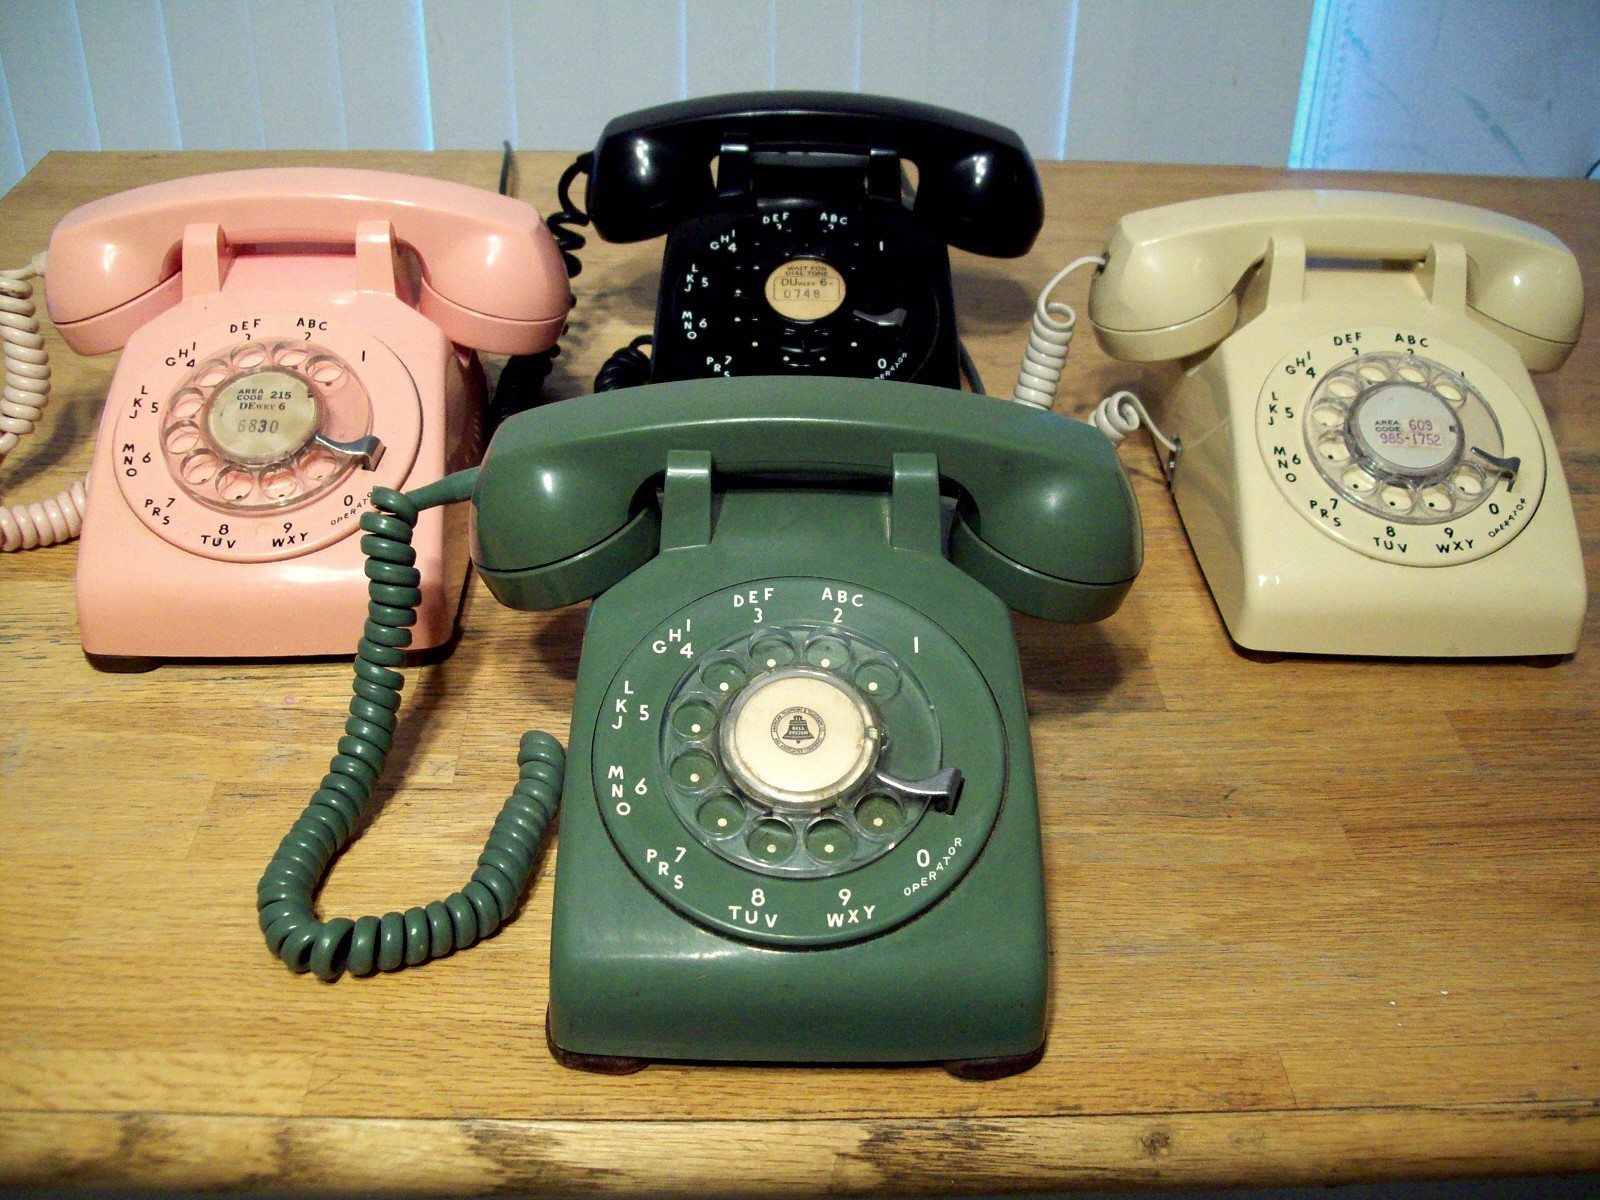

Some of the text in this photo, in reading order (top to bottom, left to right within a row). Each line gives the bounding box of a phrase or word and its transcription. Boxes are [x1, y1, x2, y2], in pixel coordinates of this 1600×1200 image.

[762, 211, 790, 225] DEF
[820, 211, 848, 225] ABC
[727, 242, 737, 252] 4
[701, 277, 709, 288] 5
[784, 289, 820, 299] 0748
[229, 318, 262, 334] DEF
[296, 317, 328, 331] ABC
[699, 318, 708, 329] 6
[1333, 331, 1362, 346] DEF
[1394, 333, 1429, 348] ABC
[186, 358, 196, 368] 4
[724, 355, 733, 365] 7
[1306, 366, 1317, 379] 4
[270, 390, 292, 400] 215
[150, 402, 159, 414] 5
[278, 402, 286, 411] 6
[1285, 406, 1295, 419] 5
[237, 419, 279, 434] 6830
[1409, 420, 1433, 431] 609
[1380, 432, 1442, 447] 985-1752
[142, 452, 152, 464] 6
[1292, 453, 1302, 466] 6
[166, 497, 177, 508] 7
[1330, 498, 1340, 510] 7
[1488, 497, 1527, 538] OPERATOR
[218, 523, 230, 536] 8
[283, 522, 293, 534] 9
[1386, 526, 1396, 538] 8
[1444, 527, 1454, 539] 9
[200, 535, 237, 549] TUV
[272, 531, 310, 549] WXY
[1372, 537, 1408, 554] TUV
[1435, 538, 1476, 555] WXY
[733, 587, 775, 608] DEF
[821, 587, 864, 608] ABC
[753, 607, 764, 624] 3
[832, 607, 843, 624] 2
[652, 618, 692, 655] GHI
[679, 642, 695, 660] 4
[638, 704, 650, 721] 5
[634, 778, 648, 796] 6
[673, 847, 687, 863] 7
[903, 837, 963, 897] OPERATOR
[750, 888, 766, 907] 8
[837, 888, 852, 907] 9
[728, 905, 778, 930] TUV
[826, 905, 877, 929] WXY
